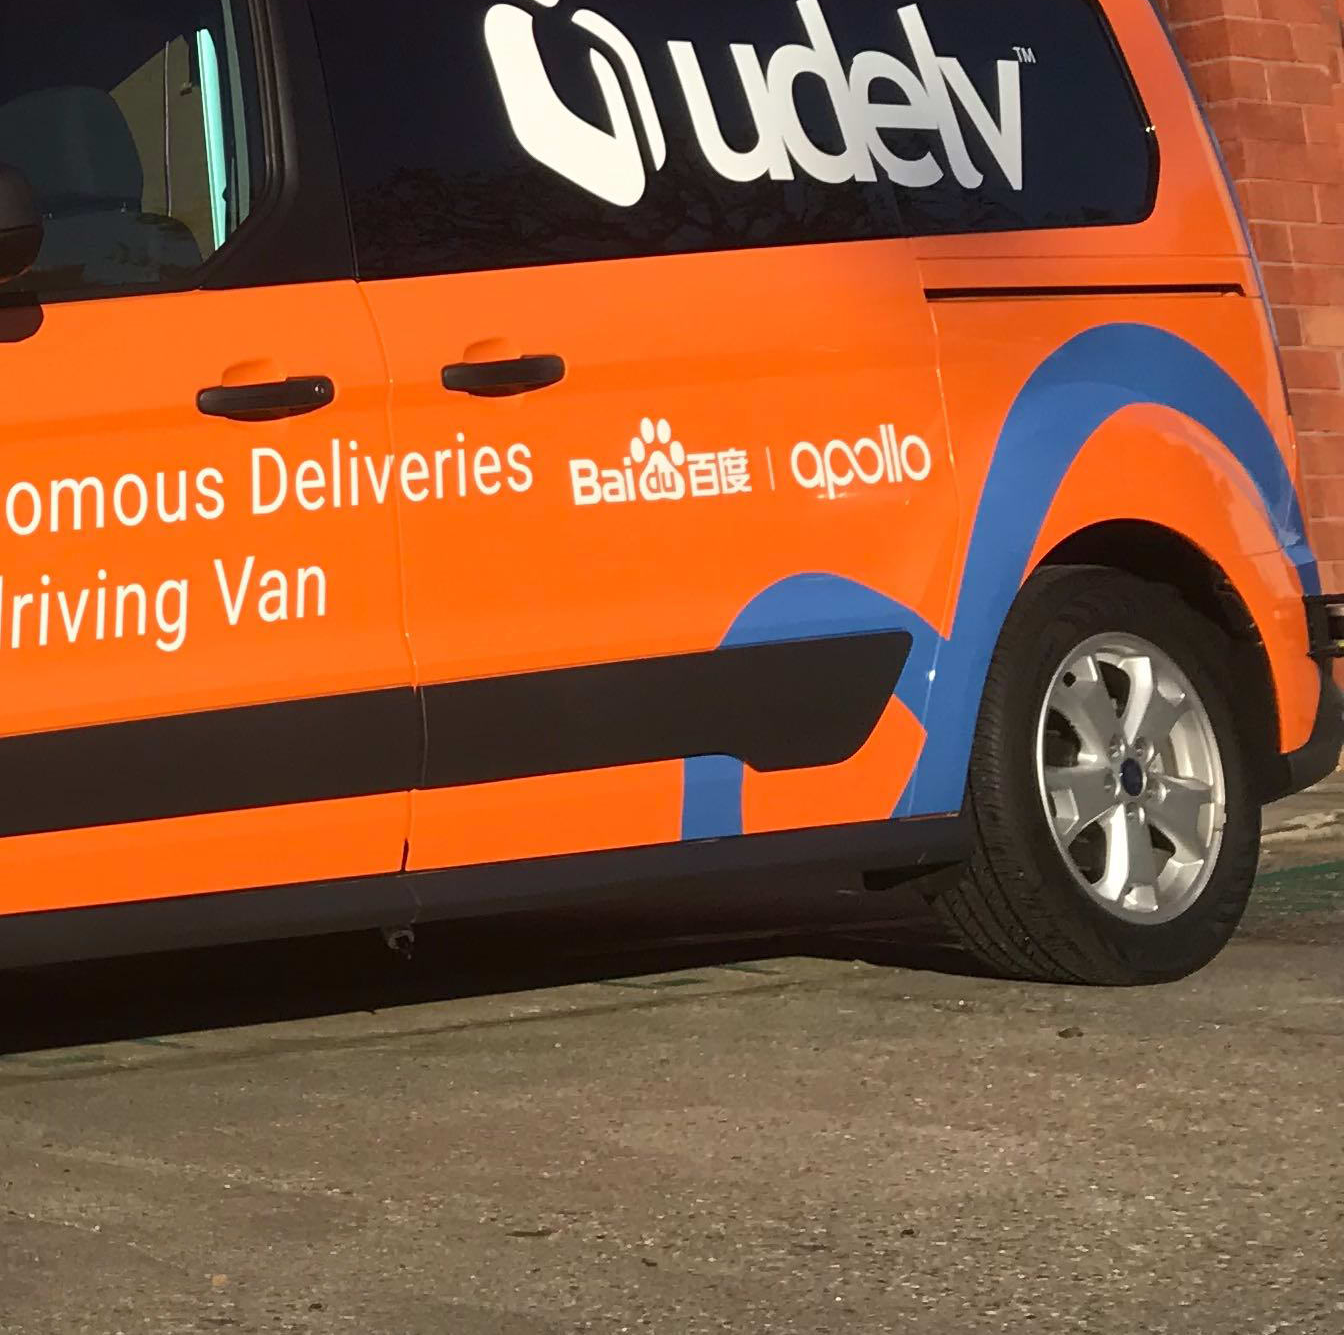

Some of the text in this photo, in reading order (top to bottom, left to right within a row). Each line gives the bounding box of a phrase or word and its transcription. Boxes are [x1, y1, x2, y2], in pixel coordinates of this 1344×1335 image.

[251, 432, 534, 515] Deliveries
[687, 449, 752, 498] 百度
[791, 424, 931, 500] apollo
[214, 555, 326, 626] Van
